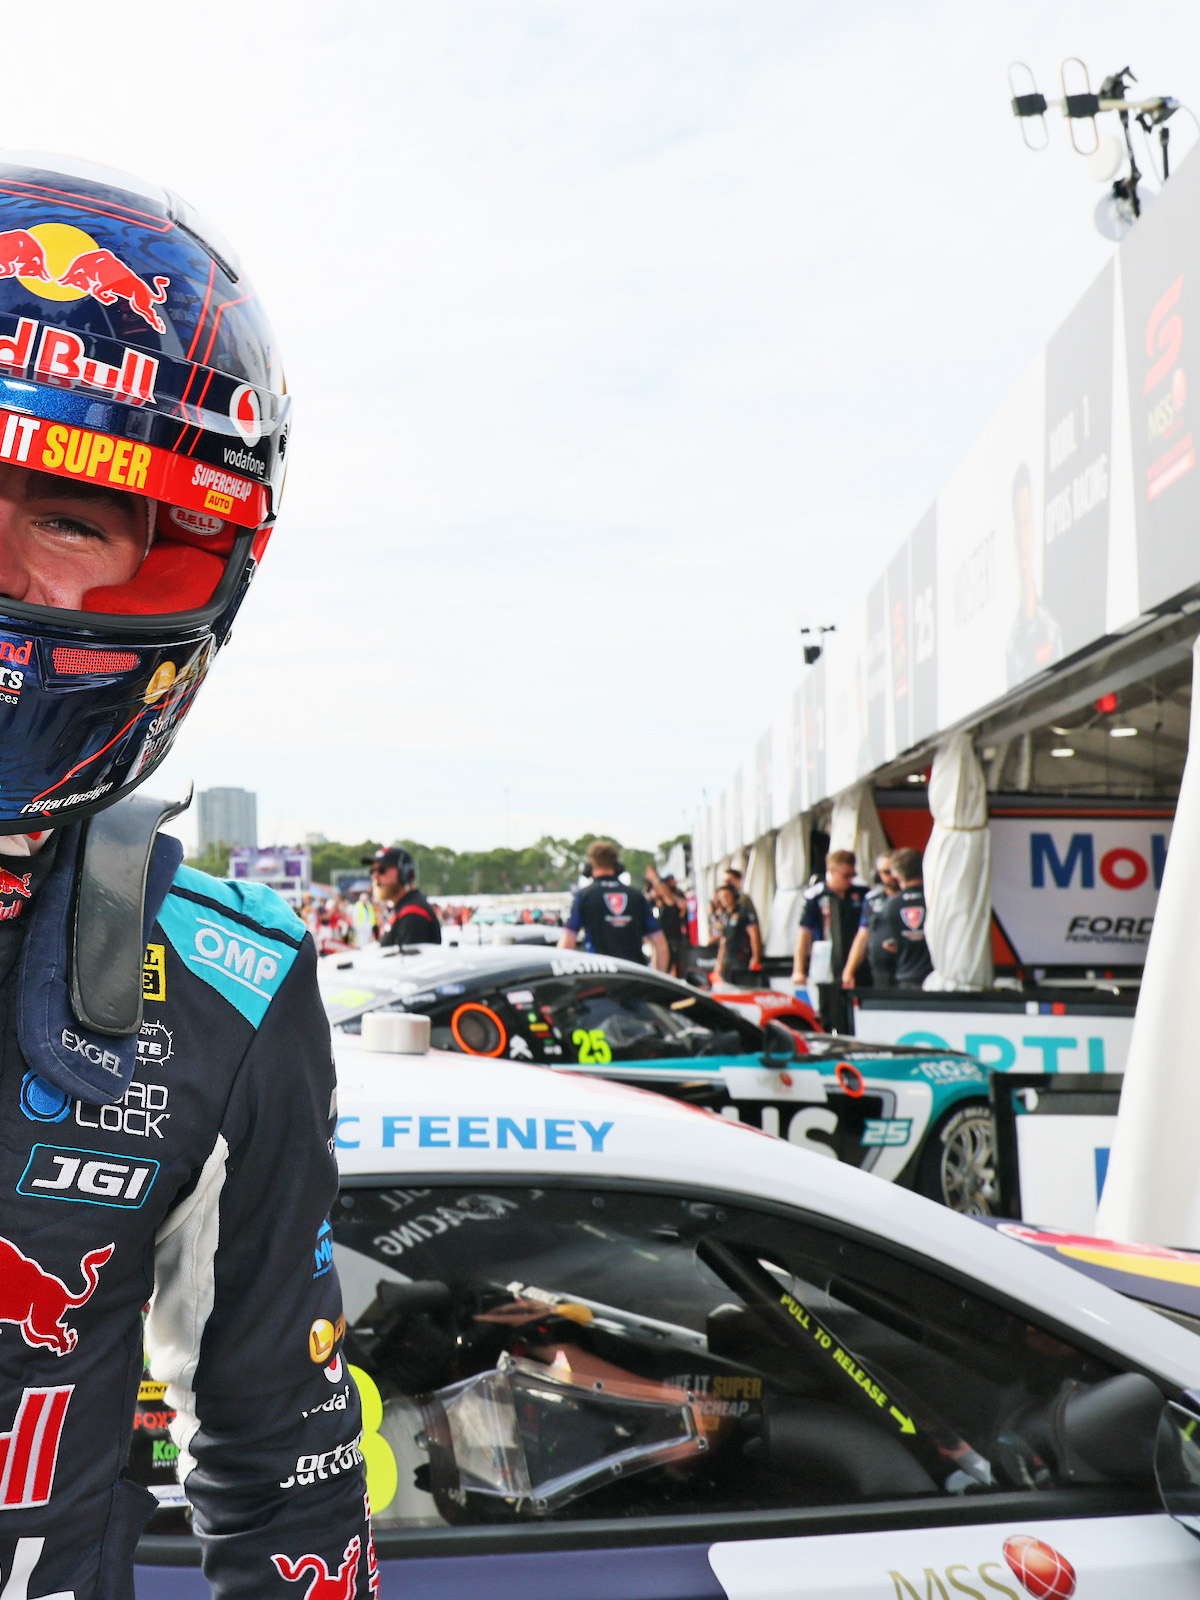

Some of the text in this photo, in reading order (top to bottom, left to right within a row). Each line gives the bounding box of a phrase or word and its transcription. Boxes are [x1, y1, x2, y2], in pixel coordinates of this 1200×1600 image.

[34, 323, 160, 404] Bull
[0, 411, 41, 462] IT
[42, 425, 152, 490] SUPER
[223, 448, 265, 476] vodafone
[191, 464, 253, 502] SUPERCHEAP
[176, 509, 215, 529] BELL
[207, 495, 230, 510] AUTO
[194, 928, 278, 985] OMP
[61, 1029, 123, 1078] EXGEL
[572, 1029, 612, 1064] 25
[381, 1116, 616, 1152] FEENEY
[861, 1119, 912, 1146] 25
[32, 1155, 153, 1200] JGI
[780, 1293, 888, 1407] PULL TO RELEASE
